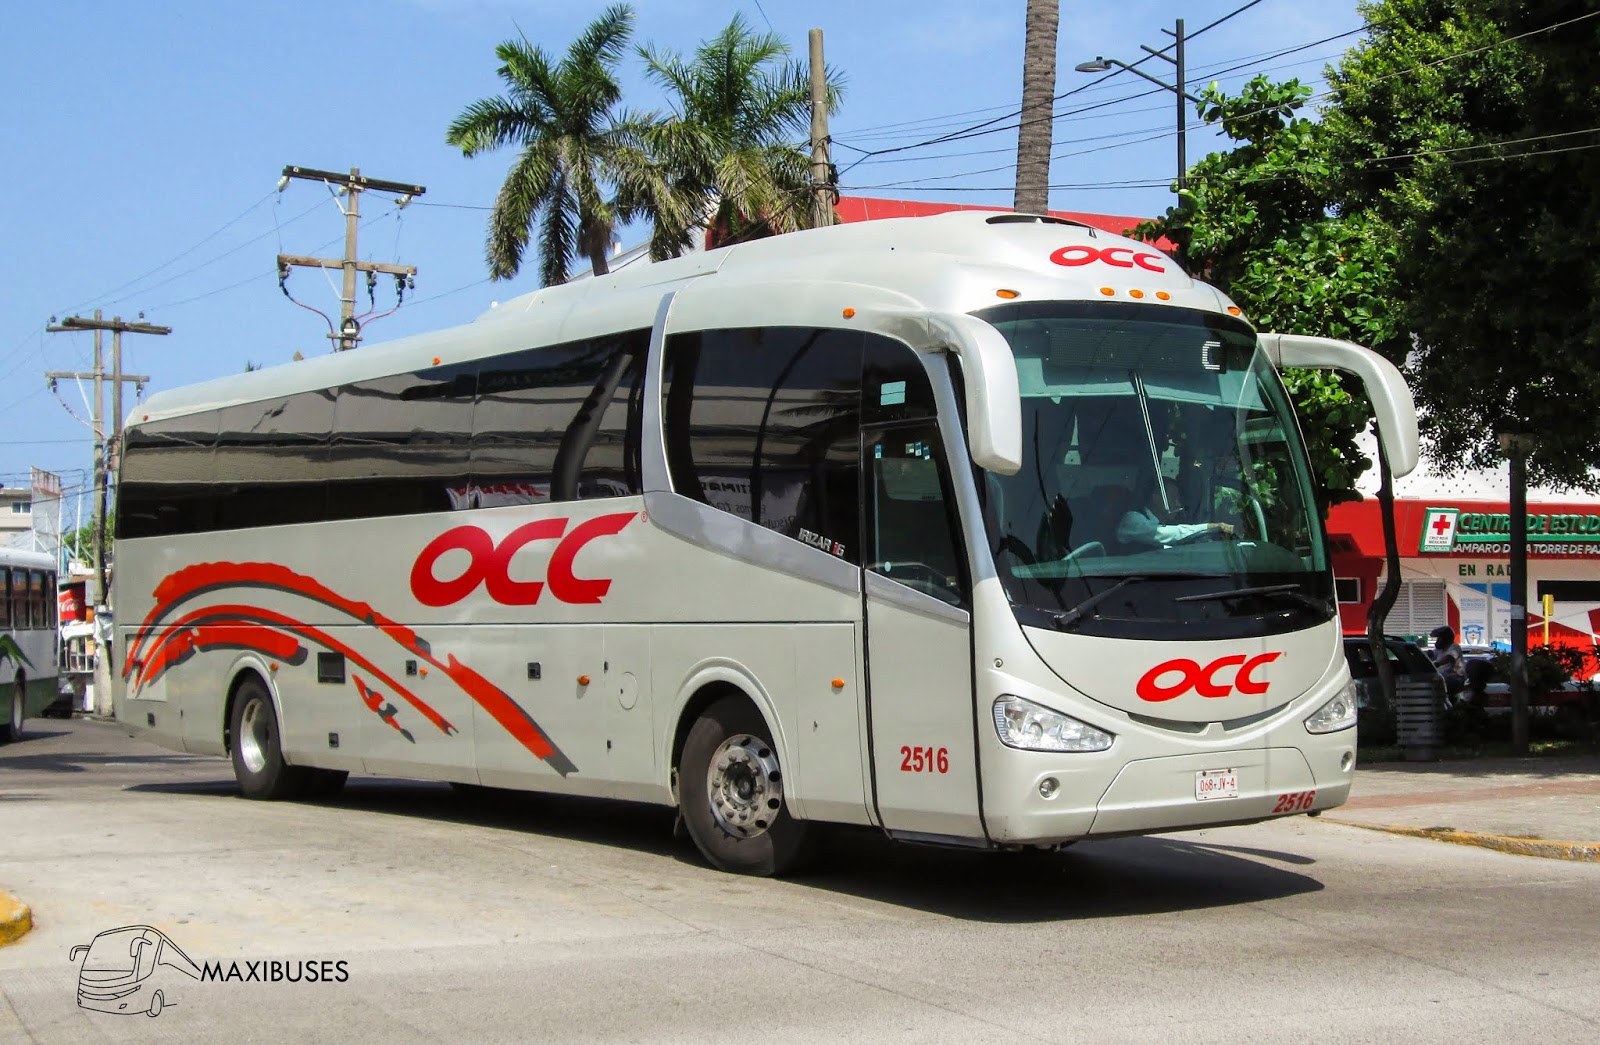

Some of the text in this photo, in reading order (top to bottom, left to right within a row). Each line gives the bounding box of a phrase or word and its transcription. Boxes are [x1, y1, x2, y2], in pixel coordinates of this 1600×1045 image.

[1050, 245, 1165, 273] OCC
[1460, 513, 1511, 530] CENTR
[799, 527, 832, 552] IRIZAR
[1454, 543, 1501, 553] AMPARO
[1533, 544, 1568, 554] TORRE
[1568, 545, 1583, 554] DE
[410, 512, 639, 607] OCC
[1459, 564, 1476, 576] EN
[1136, 652, 1282, 703] OCC
[900, 745, 949, 774] 2516
[1272, 790, 1316, 814] 2516
